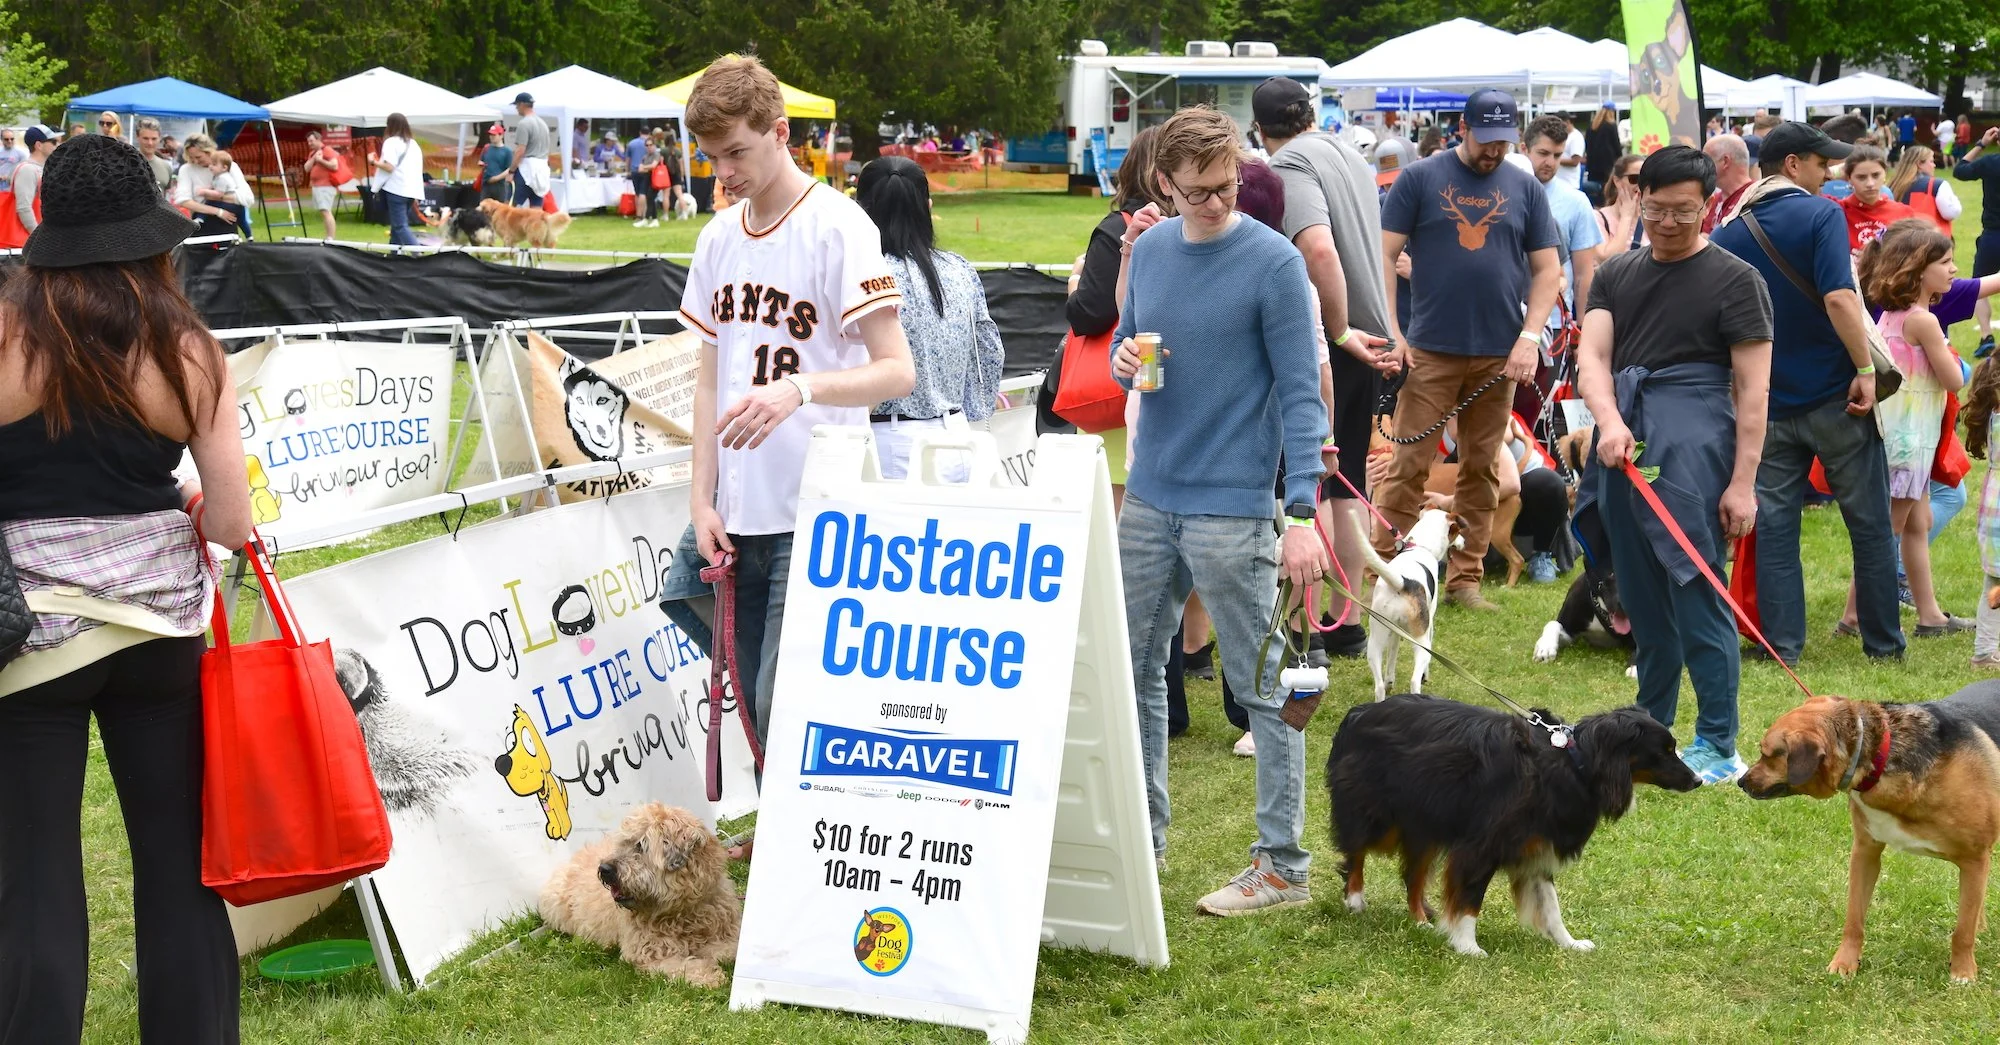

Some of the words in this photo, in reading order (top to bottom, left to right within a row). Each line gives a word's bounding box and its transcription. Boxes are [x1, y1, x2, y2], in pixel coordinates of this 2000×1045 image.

[1456, 196, 1492, 208] esker
[612, 369, 643, 389] UALITY
[752, 344, 800, 385] 18
[632, 384, 655, 400] NGLE
[267, 426, 341, 469] LURE
[341, 417, 430, 452] OURSE
[808, 511, 1064, 603] Obstacle
[822, 597, 1025, 689] Course
[532, 648, 642, 737] LURE
[880, 702, 933, 720] sponsored
[935, 703, 948, 724] by
[825, 738, 990, 780] GARAVEL
[813, 784, 846, 794] SUBARU
[896, 789, 922, 802] Jeep
[984, 800, 1010, 810] RAM
[813, 817, 852, 853] $10
[859, 826, 892, 857] for
[898, 831, 914, 860] 2
[920, 838, 973, 867] runs
[823, 859, 881, 892] 10am
[911, 869, 962, 905] 4pm
[876, 949, 904, 960] Festival
[878, 936, 902, 953] Dog
